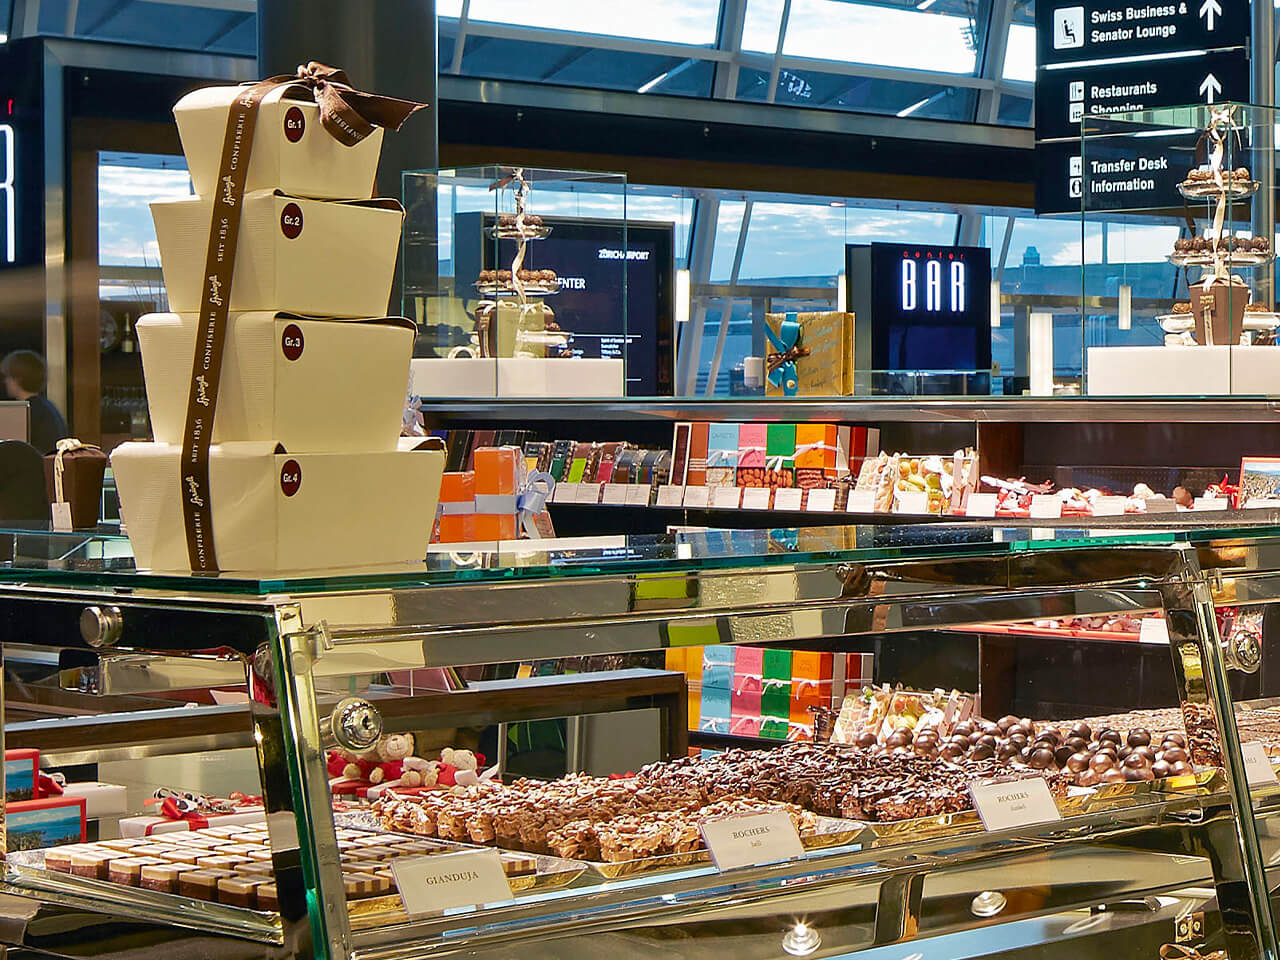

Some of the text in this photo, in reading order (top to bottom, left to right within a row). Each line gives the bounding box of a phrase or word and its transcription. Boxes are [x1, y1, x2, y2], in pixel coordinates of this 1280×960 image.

[1091, 2, 1187, 23] Swiss Business &
[1091, 25, 1176, 42] Senator Lounge
[1091, 81, 1157, 98] Restaurants
[1091, 157, 1167, 173] Transfer Desk
[1091, 178, 1154, 193] Information
[903, 251, 966, 259] center
[555, 277, 586, 289] ENTER
[902, 259, 966, 312] BAR
[732, 825, 770, 839] ROCHERS
[426, 871, 479, 885] GIANDUJA
